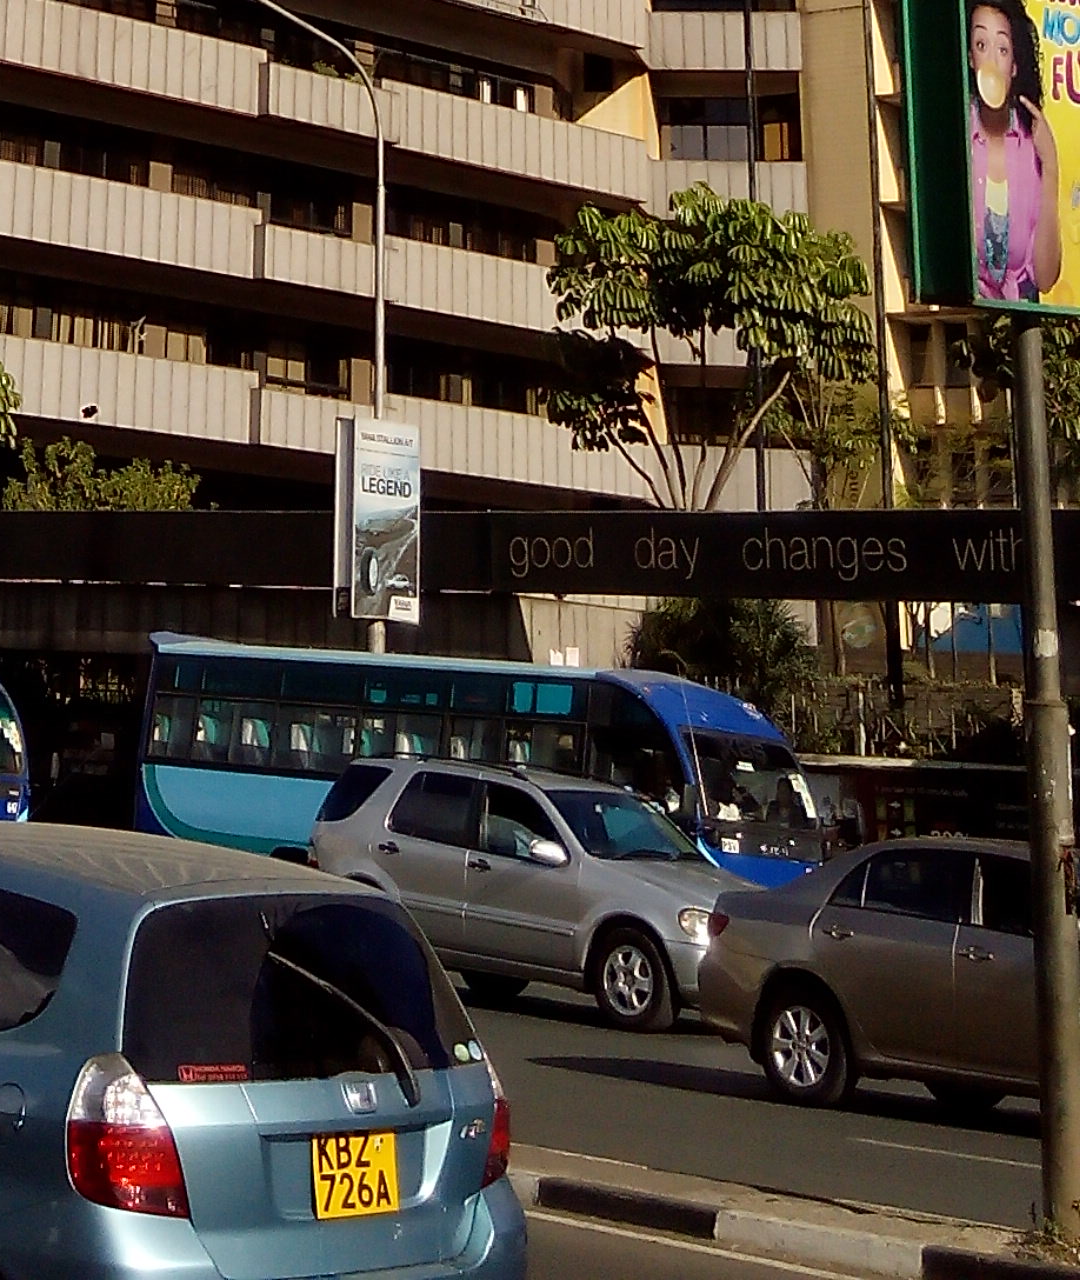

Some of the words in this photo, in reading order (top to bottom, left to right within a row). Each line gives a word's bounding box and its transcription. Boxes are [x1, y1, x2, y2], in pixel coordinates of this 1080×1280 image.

[1042, 7, 1080, 46] MO
[361, 476, 412, 498] LEGEND
[508, 527, 594, 578] good
[634, 527, 700, 580] day
[742, 527, 908, 582] changes
[318, 1134, 371, 1173] KBZ
[320, 1170, 392, 1213] 726A
